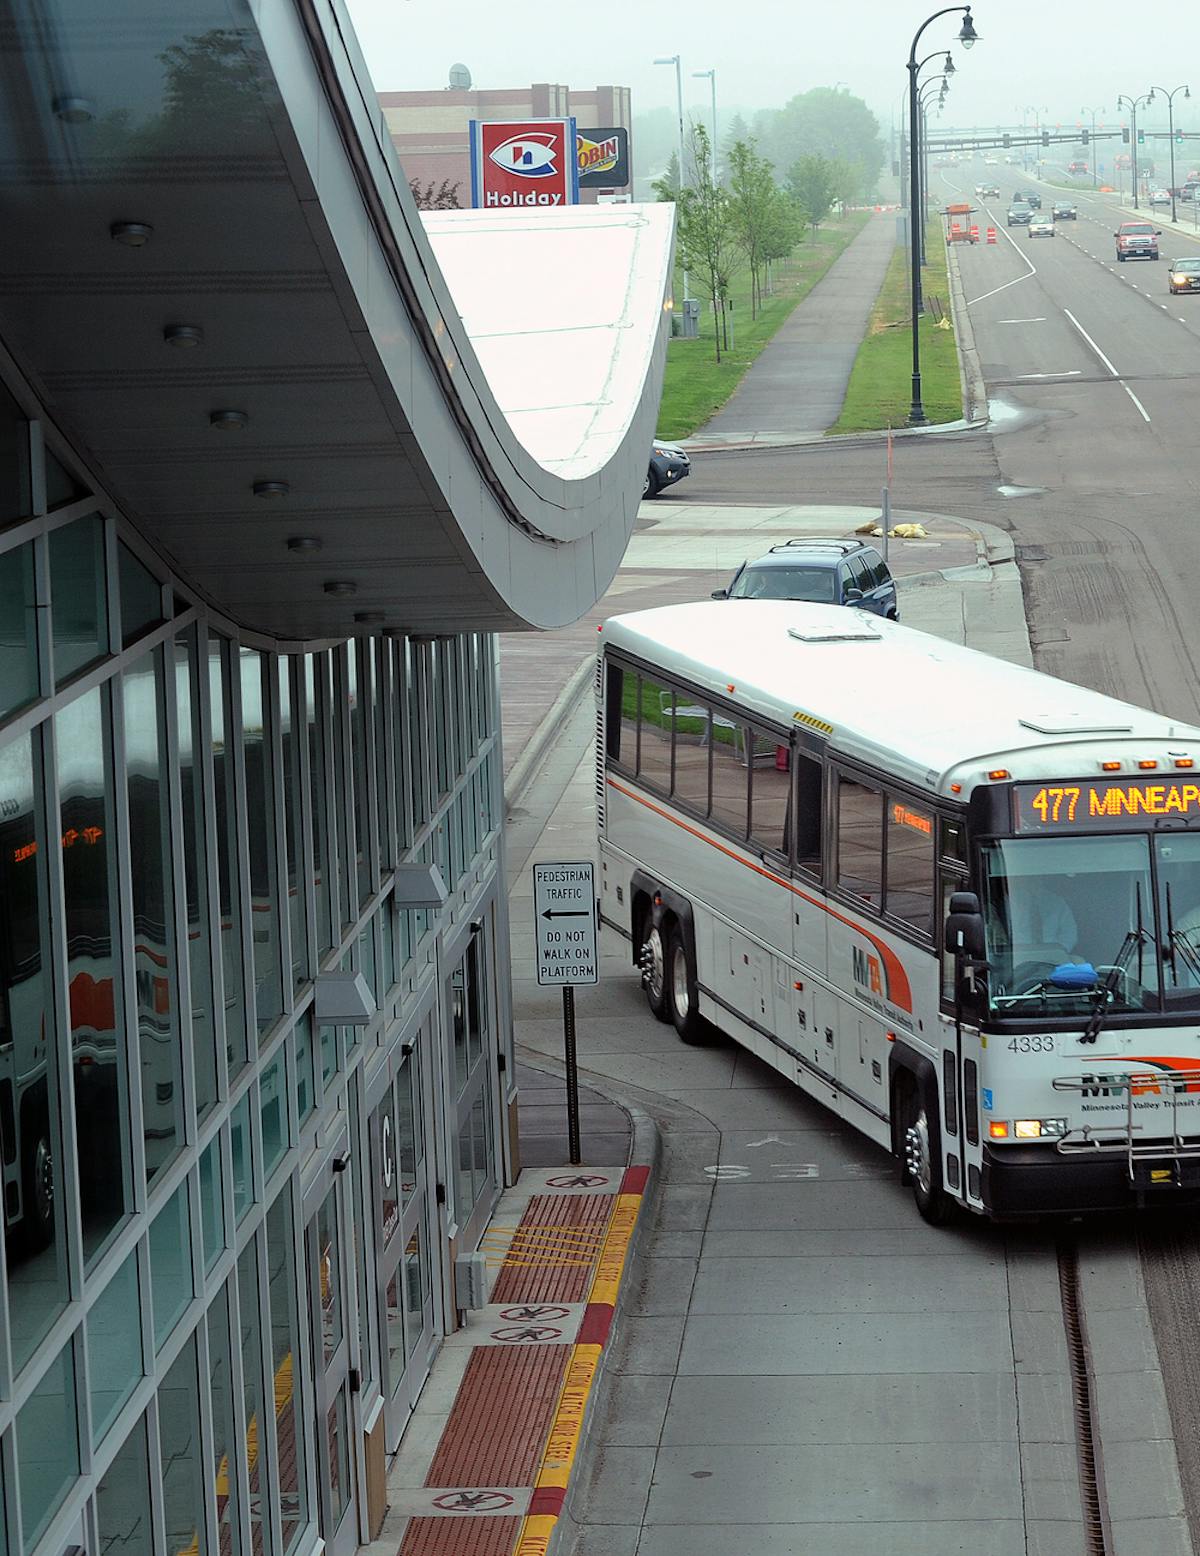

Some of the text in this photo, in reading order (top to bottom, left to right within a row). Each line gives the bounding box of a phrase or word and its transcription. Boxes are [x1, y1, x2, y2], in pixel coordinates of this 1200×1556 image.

[577, 139, 617, 168] OBIN
[486, 190, 562, 207] Holiday
[1032, 786, 1081, 822] 477
[537, 870, 591, 882] PEDESTRIAN
[546, 888, 582, 899] TRAFFIC
[547, 930, 586, 942] DO NOT
[543, 947, 590, 960] WALK ON
[541, 965, 594, 977] PLATFORM
[1008, 1035, 1055, 1053] 4333
[1133, 1099, 1160, 1111] Valley
